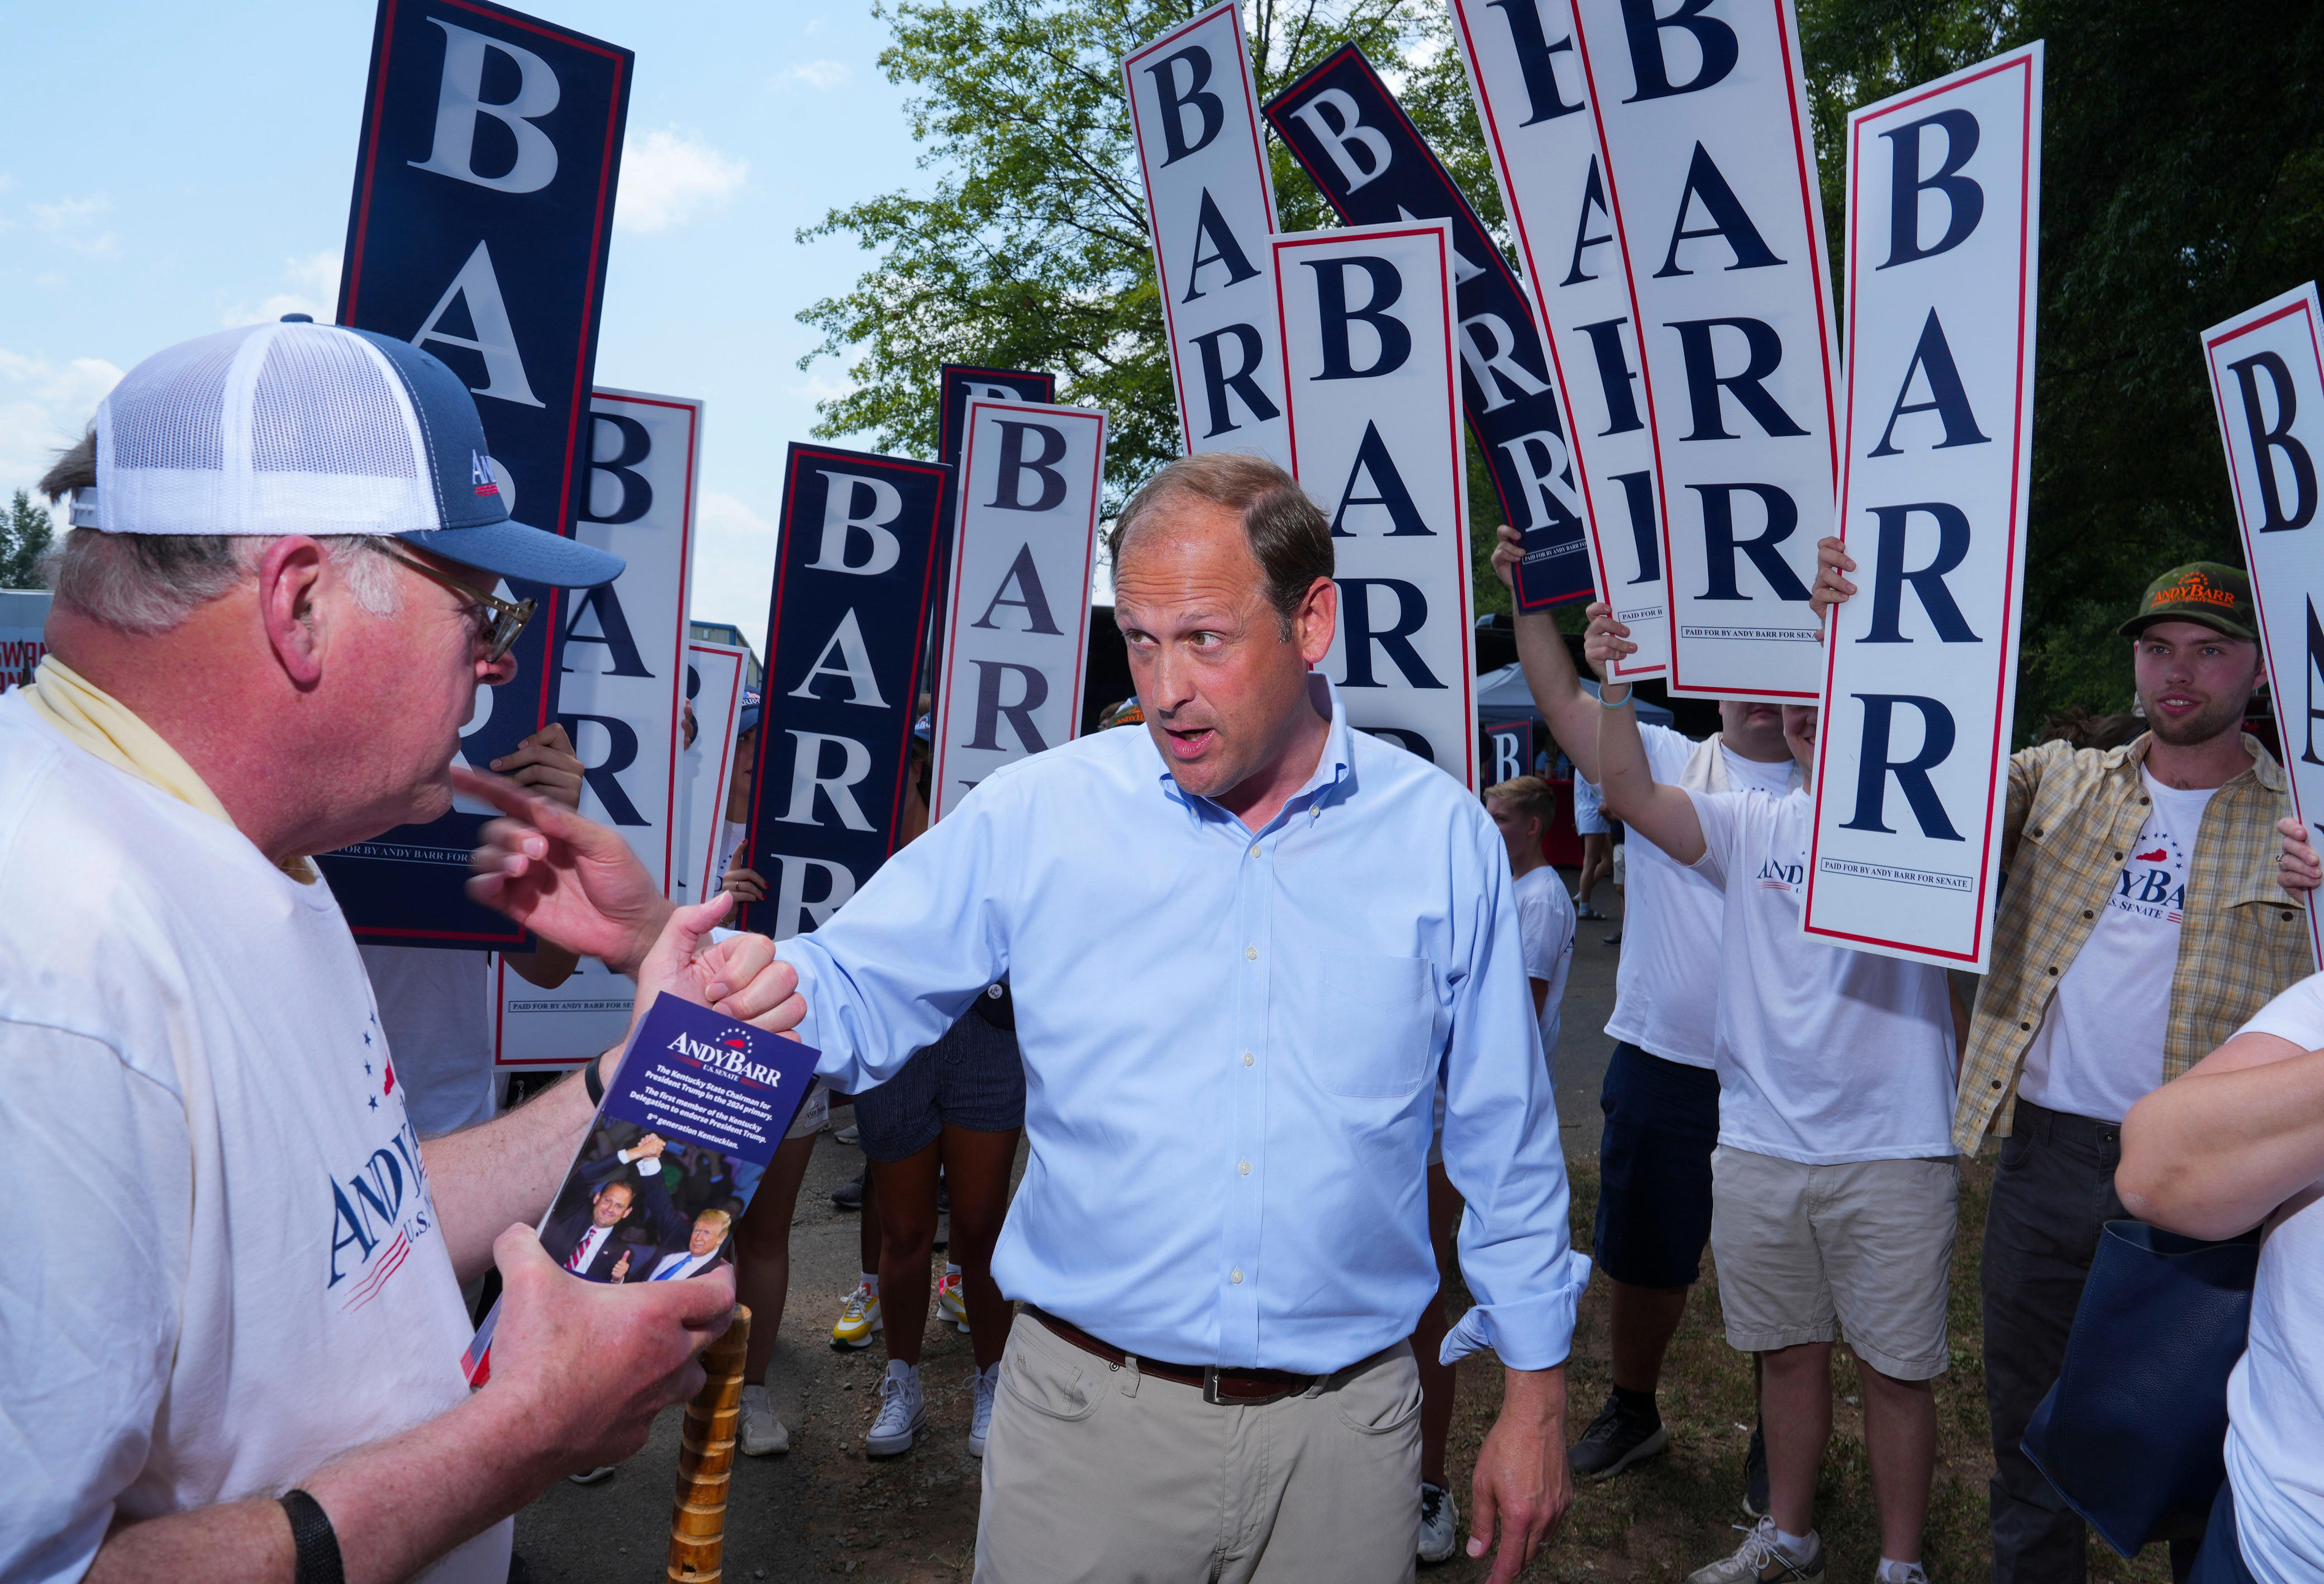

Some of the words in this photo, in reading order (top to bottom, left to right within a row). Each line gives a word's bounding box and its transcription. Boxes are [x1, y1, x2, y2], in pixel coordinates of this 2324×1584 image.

[1621, 0, 1813, 602] BARR
[1839, 108, 1992, 842] BARR
[958, 418, 1068, 789] BAR
[771, 469, 903, 940] BARR
[380, 848, 411, 857] ANDY
[415, 850, 444, 860] BARR
[447, 853, 468, 862] FOR
[1844, 864, 1858, 873] FOR
[1871, 868, 1893, 877] ANDY
[1894, 871, 1916, 881] BARR
[1918, 874, 1934, 883] FOR
[1936, 877, 1968, 887] SENATE
[2120, 901, 2163, 919] SENATE
[645, 1071, 680, 1088] President
[682, 1084, 705, 1098] Trump
[706, 1091, 713, 1100] in
[714, 1095, 726, 1105] the
[726, 1100, 743, 1111] 2024
[742, 1106, 772, 1121] primary.
[657, 1064, 670, 1075] The
[671, 1069, 704, 1088] Kentucky
[706, 1082, 725, 1095] State
[726, 1090, 760, 1107] Chairman
[760, 1100, 771, 1110] for
[702, 1064, 714, 1073] U.S.
[715, 1068, 740, 1082] SENATE
[630, 1091, 670, 1110] Delegation
[670, 1105, 679, 1114] to
[679, 1110, 708, 1124] endorse
[709, 1119, 742, 1135] President
[743, 1130, 766, 1143] Trump.
[645, 1086, 659, 1096] The
[659, 1091, 675, 1102] first
[676, 1097, 707, 1114] member
[707, 1108, 716, 1117] of
[716, 1111, 728, 1121] the
[728, 1115, 762, 1133] Kentucky
[656, 1117, 697, 1136] generation
[697, 1130, 739, 1149] Kentuckian.
[403, 1211, 431, 1244] U.S.
